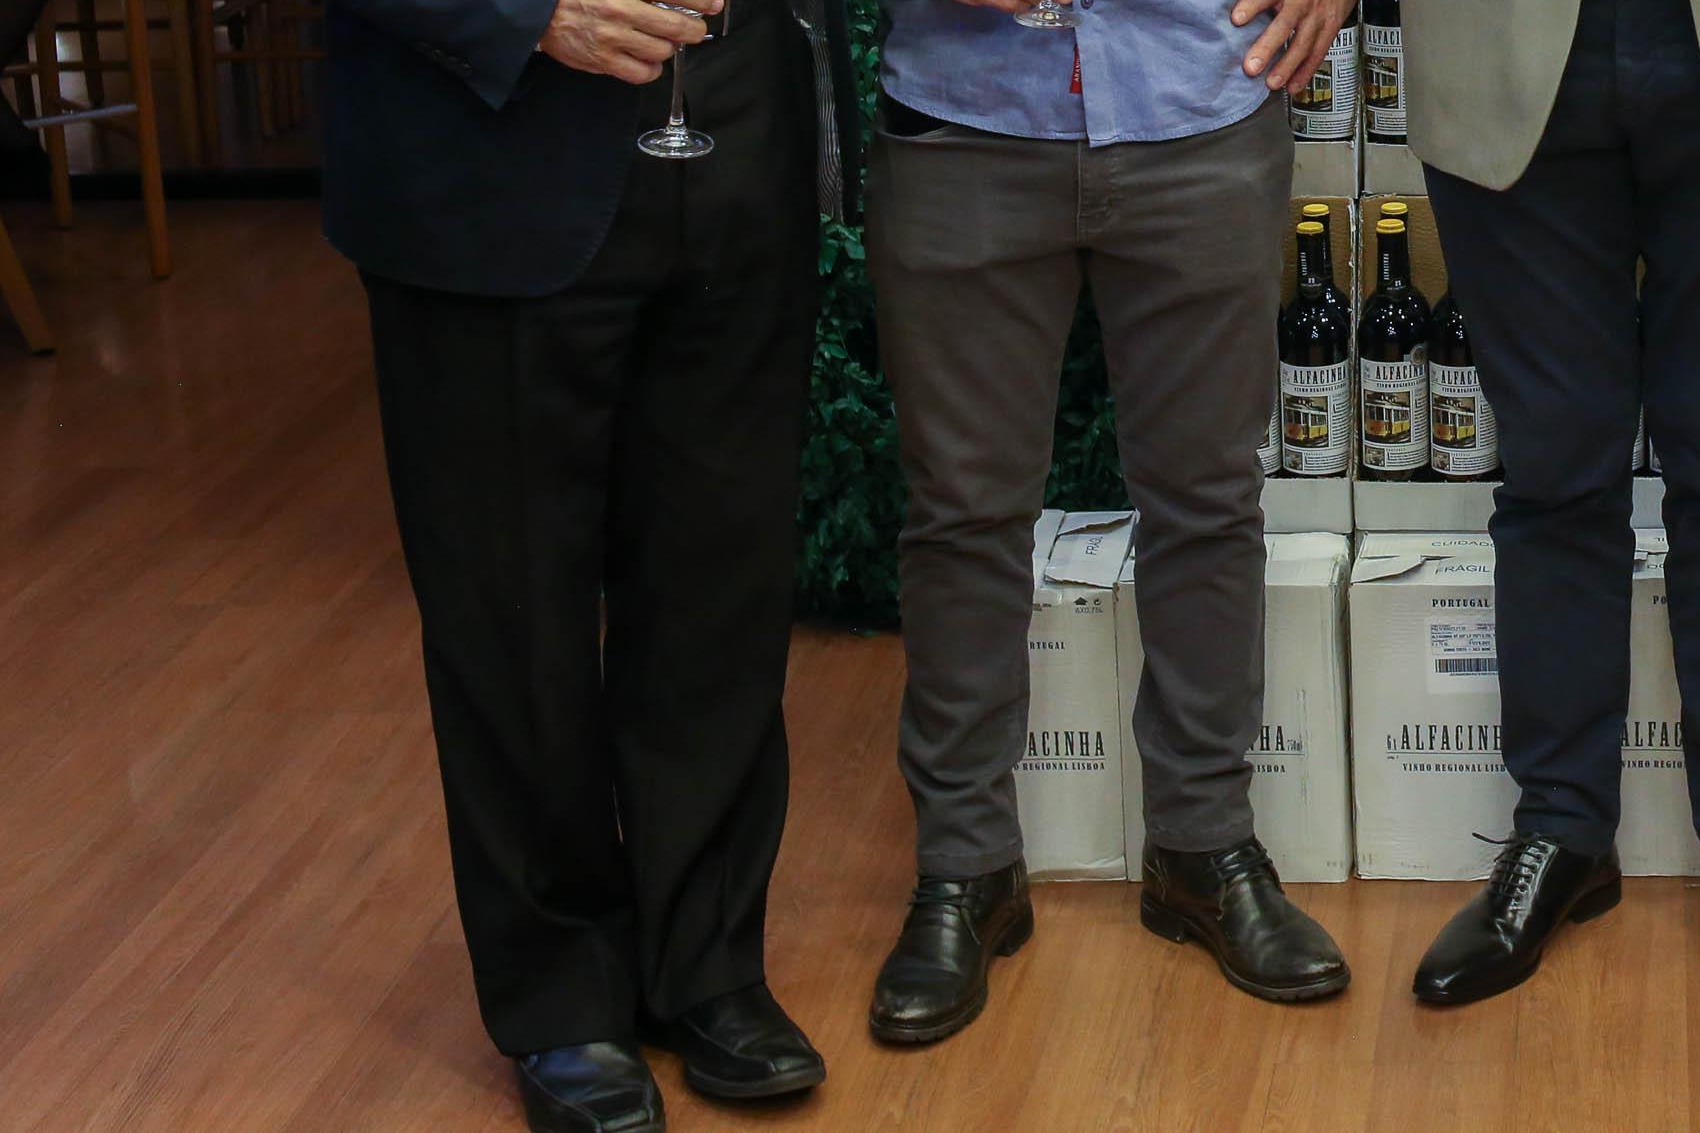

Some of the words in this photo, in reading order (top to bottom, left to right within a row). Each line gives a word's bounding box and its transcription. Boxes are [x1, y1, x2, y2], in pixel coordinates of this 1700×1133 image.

[1368, 28, 1400, 45] ALFACI
[1441, 369, 1479, 386] ALFACI
[1432, 598, 1489, 608] PORTUGAL
[1029, 641, 1066, 650] RTUGAL
[1401, 724, 1501, 751] ALFACINH
[1620, 721, 1682, 747] ALFAC
[1028, 730, 1105, 756] ACINHA
[1022, 761, 1069, 771] REGIONAL
[1072, 761, 1105, 771] LISBOA
[1402, 762, 1432, 772] VINHO
[1435, 763, 1482, 772] REGIONAL
[1485, 763, 1506, 772] LISB
[1653, 760, 1683, 769] REGIO
